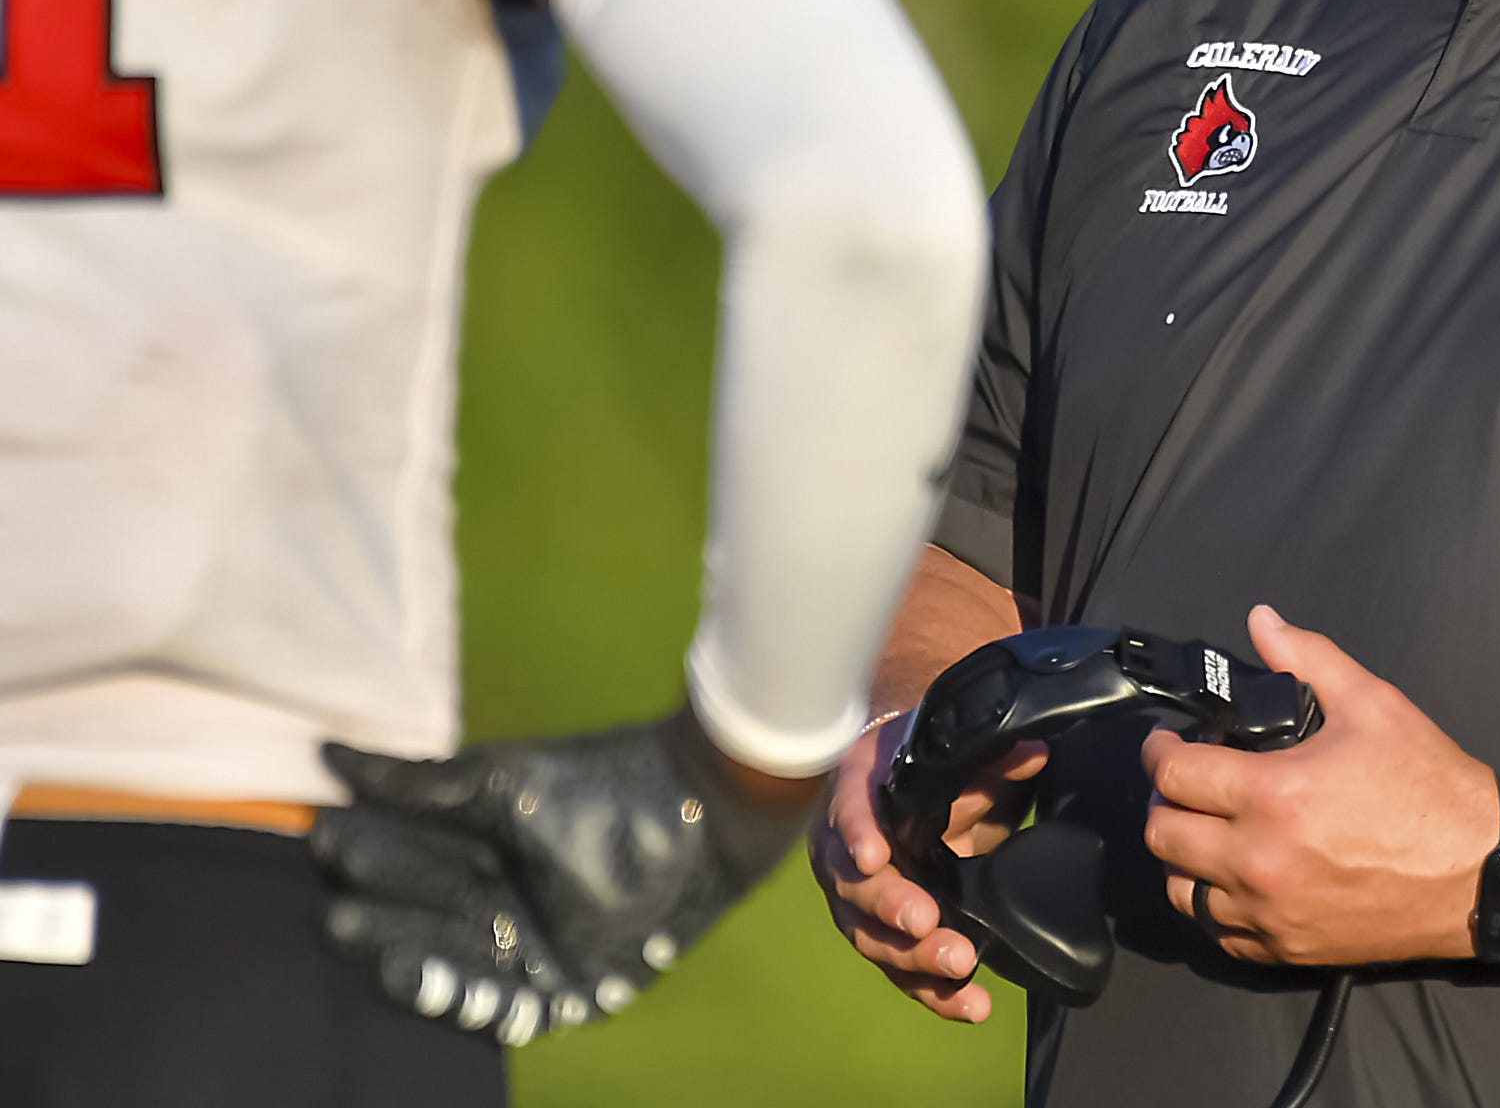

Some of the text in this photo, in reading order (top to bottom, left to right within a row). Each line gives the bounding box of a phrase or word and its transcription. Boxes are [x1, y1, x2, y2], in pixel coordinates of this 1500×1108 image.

[1186, 41, 1322, 76] COLERAIN
[1138, 189, 1229, 215] FOOTBALL
[1204, 649, 1219, 695] PORTA
[1216, 654, 1232, 703] PHONE
